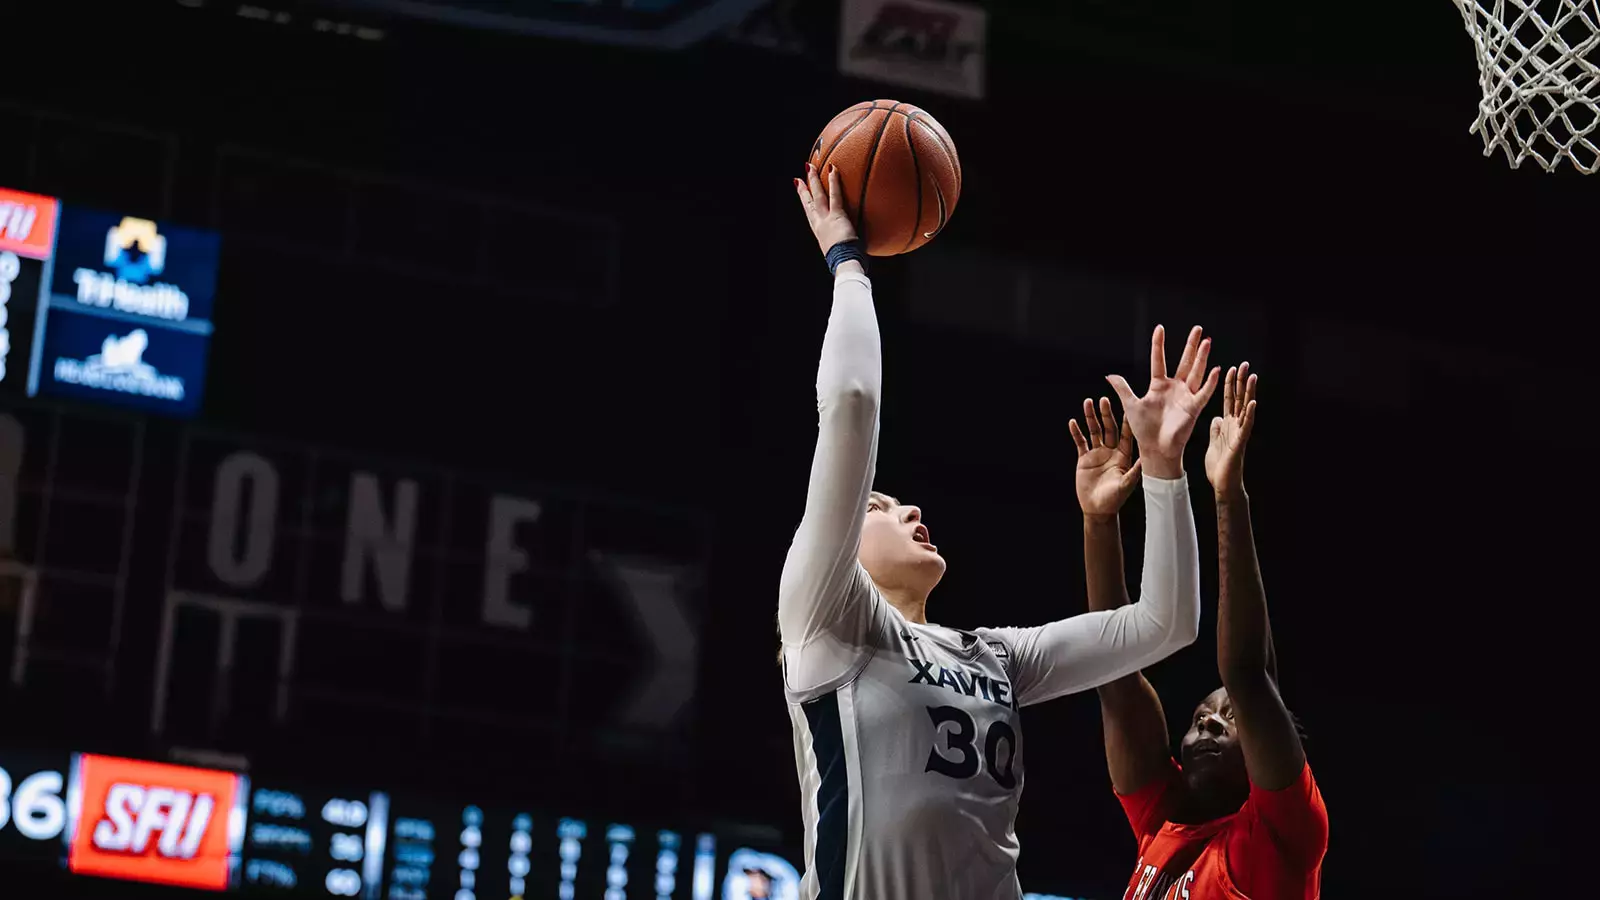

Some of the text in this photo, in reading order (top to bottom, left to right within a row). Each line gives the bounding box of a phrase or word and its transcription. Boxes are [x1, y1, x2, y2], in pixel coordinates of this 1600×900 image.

[206, 450, 542, 631] ONE
[907, 658, 1018, 712] XAVIE
[925, 705, 1017, 790] 30
[0, 766, 67, 840] 6
[93, 782, 214, 859] SFU
